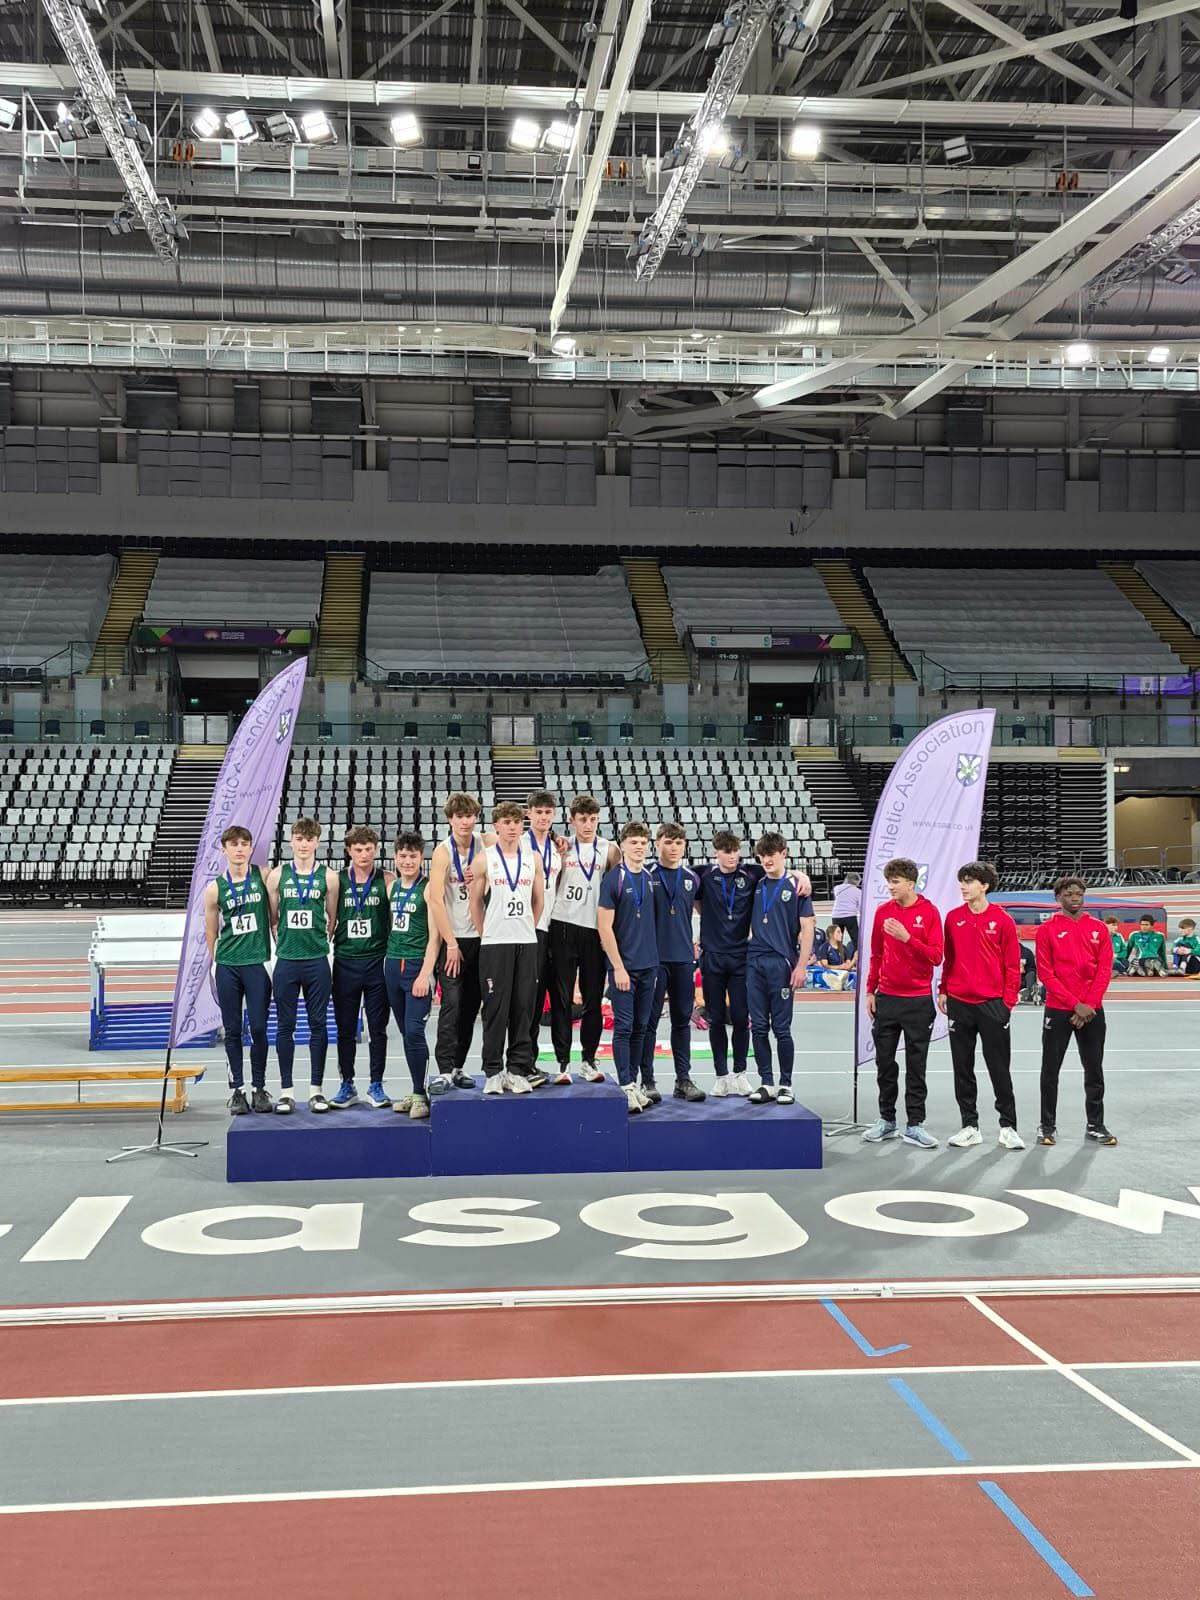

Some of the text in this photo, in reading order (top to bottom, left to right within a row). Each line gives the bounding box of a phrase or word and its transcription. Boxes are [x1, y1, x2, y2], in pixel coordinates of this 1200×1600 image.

[895, 720, 985, 799] Association
[283, 887, 321, 899] IREAND
[566, 885, 583, 901] 30
[344, 896, 380, 908] IREAND
[507, 901, 524, 916] 29
[236, 915, 252, 931] 47
[291, 911, 309, 927] 46
[350, 921, 368, 935] 45
[0, 1187, 1200, 1262] lasgow
